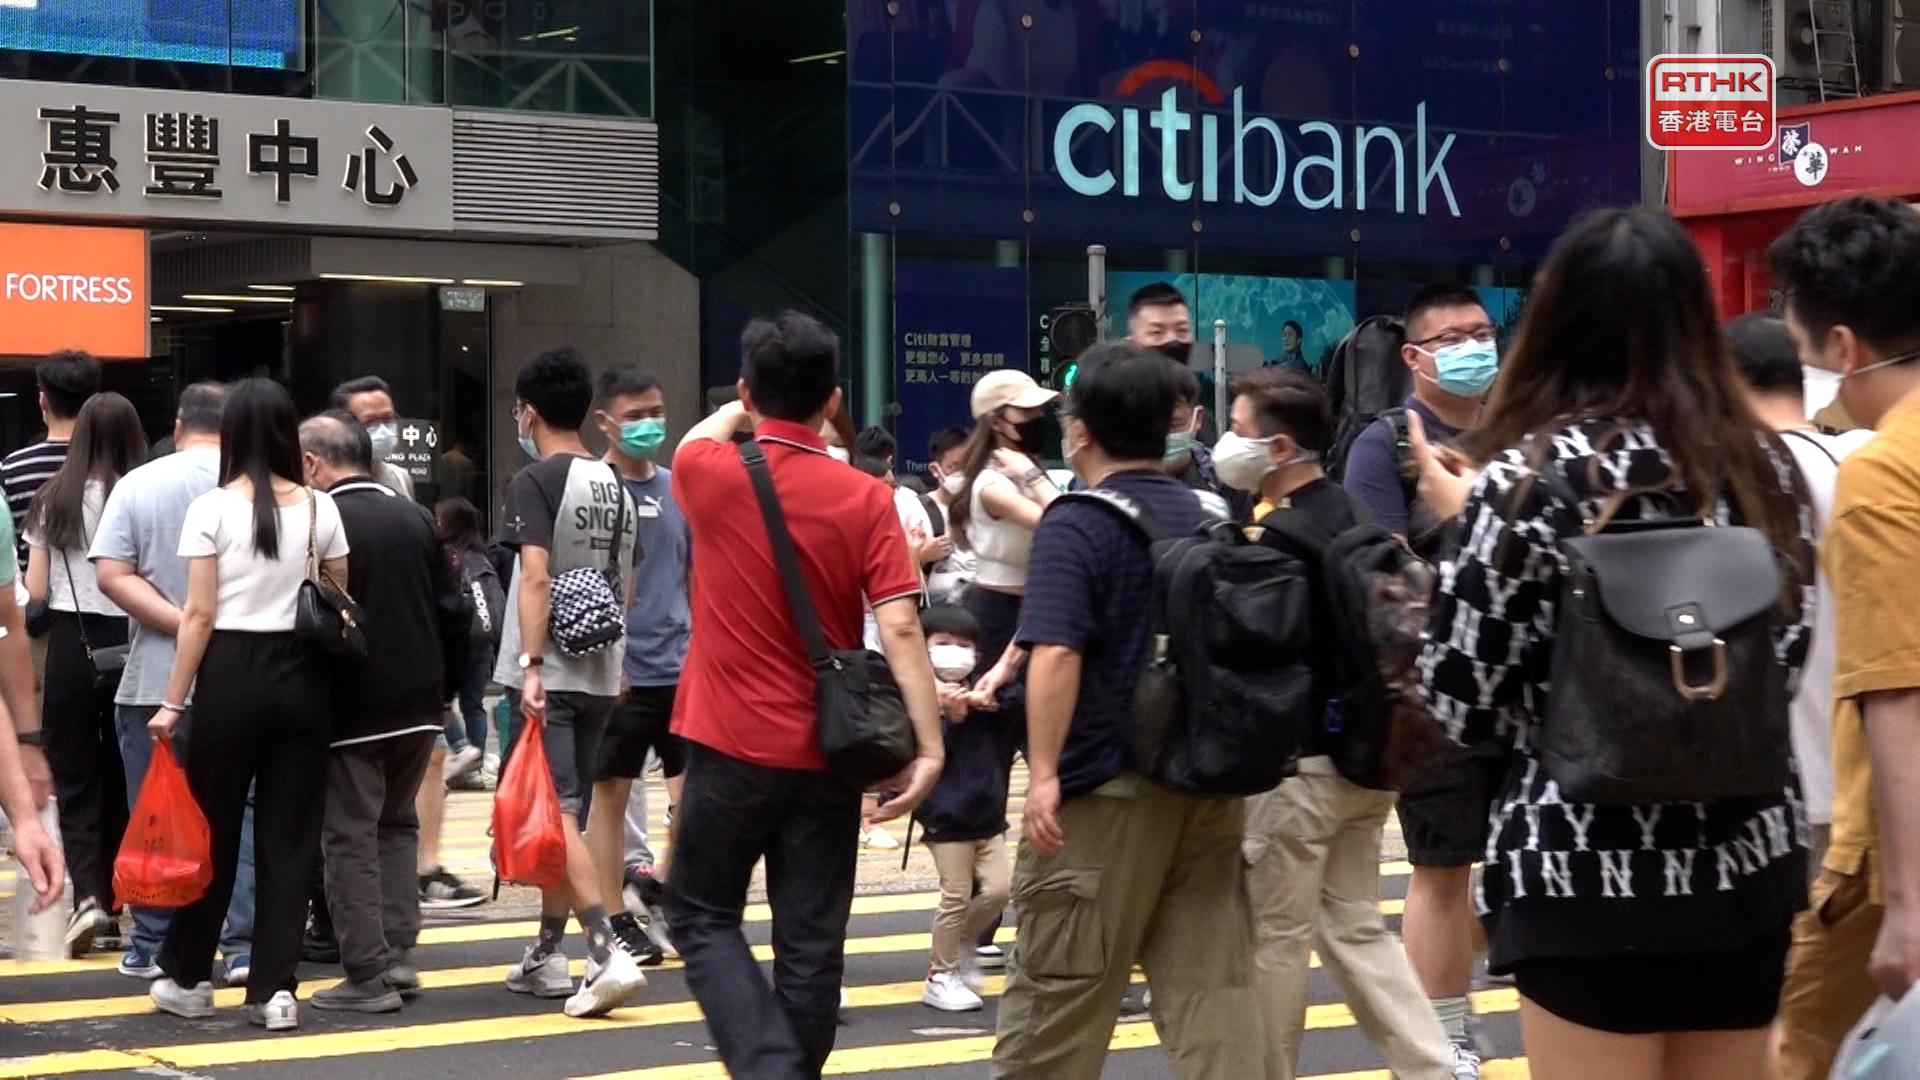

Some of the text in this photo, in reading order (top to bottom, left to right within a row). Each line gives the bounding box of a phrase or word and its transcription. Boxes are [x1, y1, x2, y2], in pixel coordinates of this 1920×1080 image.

[37, 105, 420, 207] 惠豐中心
[1053, 85, 1462, 218] citibank
[1734, 152, 1776, 167] WING
[6, 272, 133, 304] FORTRESS
[906, 458, 928, 472] Ther
[589, 481, 620, 504] BIG
[575, 505, 633, 534] SINGE
